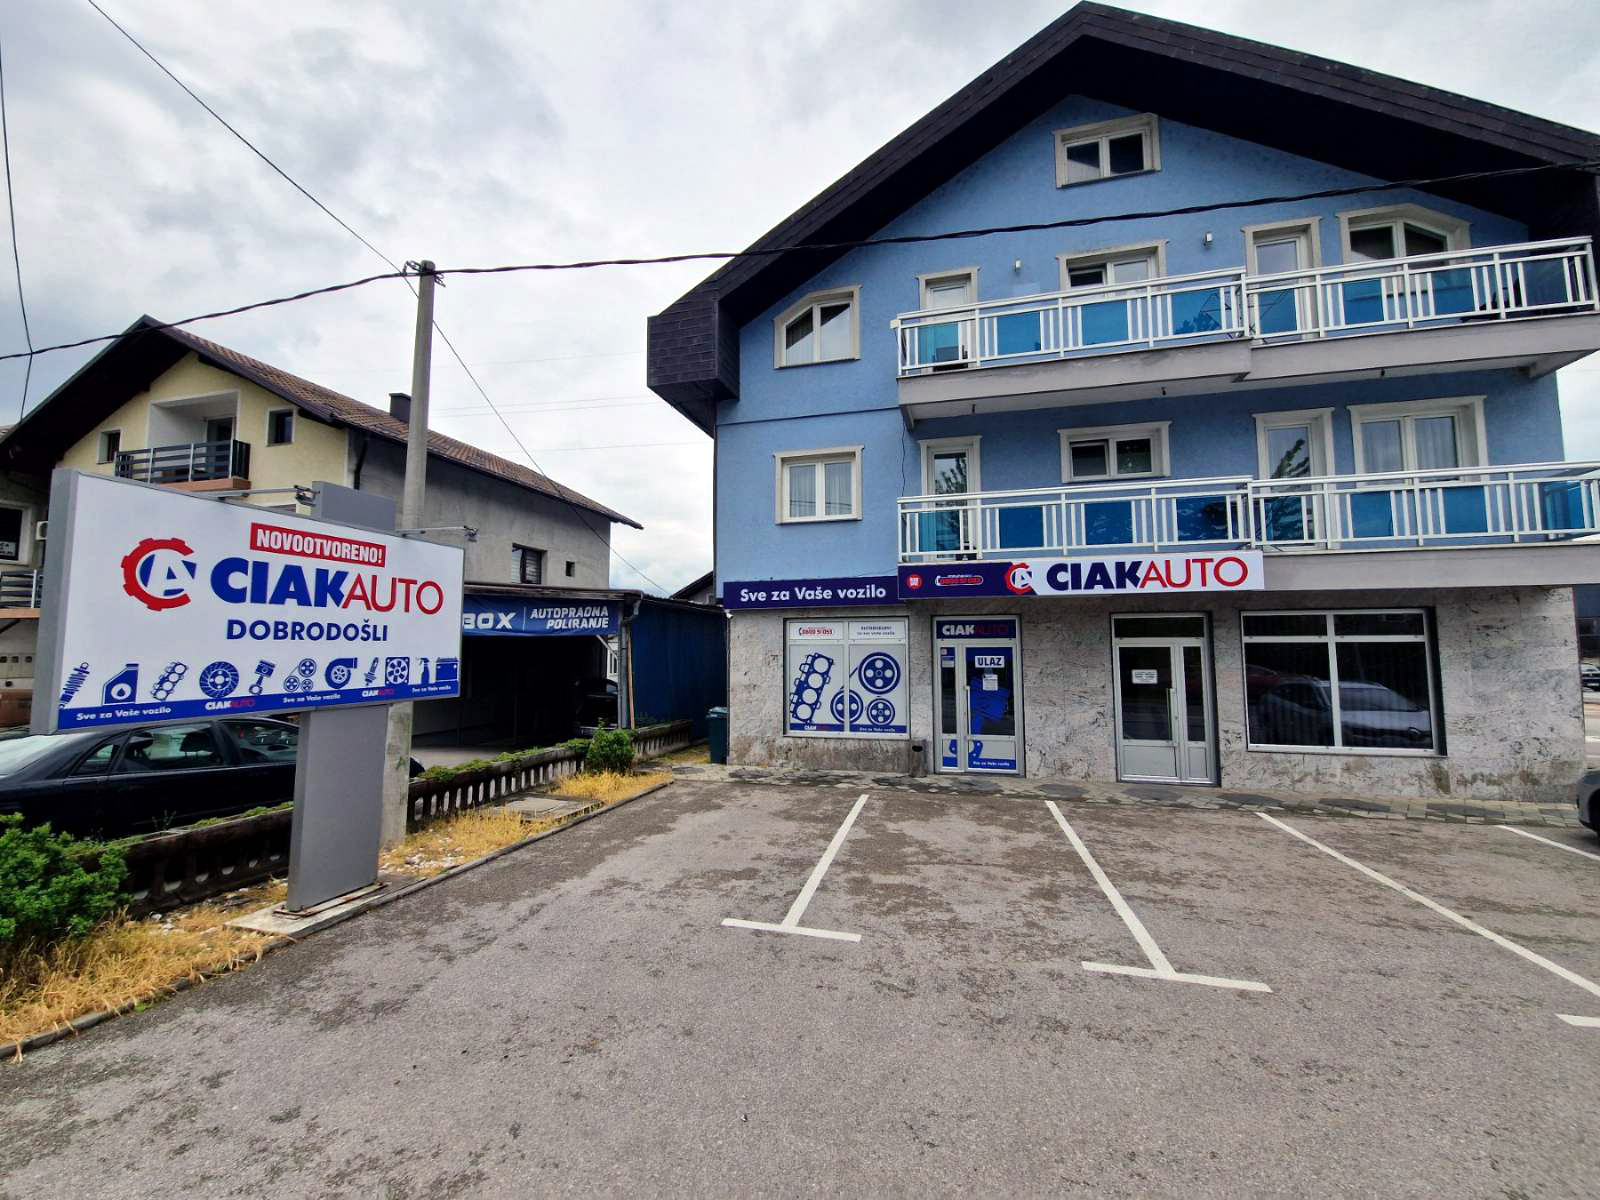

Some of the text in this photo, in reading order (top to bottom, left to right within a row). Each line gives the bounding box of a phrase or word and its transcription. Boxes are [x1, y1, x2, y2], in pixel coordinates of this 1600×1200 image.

[256, 528, 383, 563] NOVOOTVORENO!
[1046, 556, 1249, 592] CIAKAUTO
[210, 557, 444, 615] CIAKAUTO
[740, 584, 886, 602] Sve za Vaše vozilo
[226, 618, 388, 642] DOBRODOŠLI
[546, 617, 609, 630] POLIRANJE
[977, 657, 1002, 667] ULAZ
[76, 712, 96, 721] Sve
[142, 706, 172, 716] vozilo
